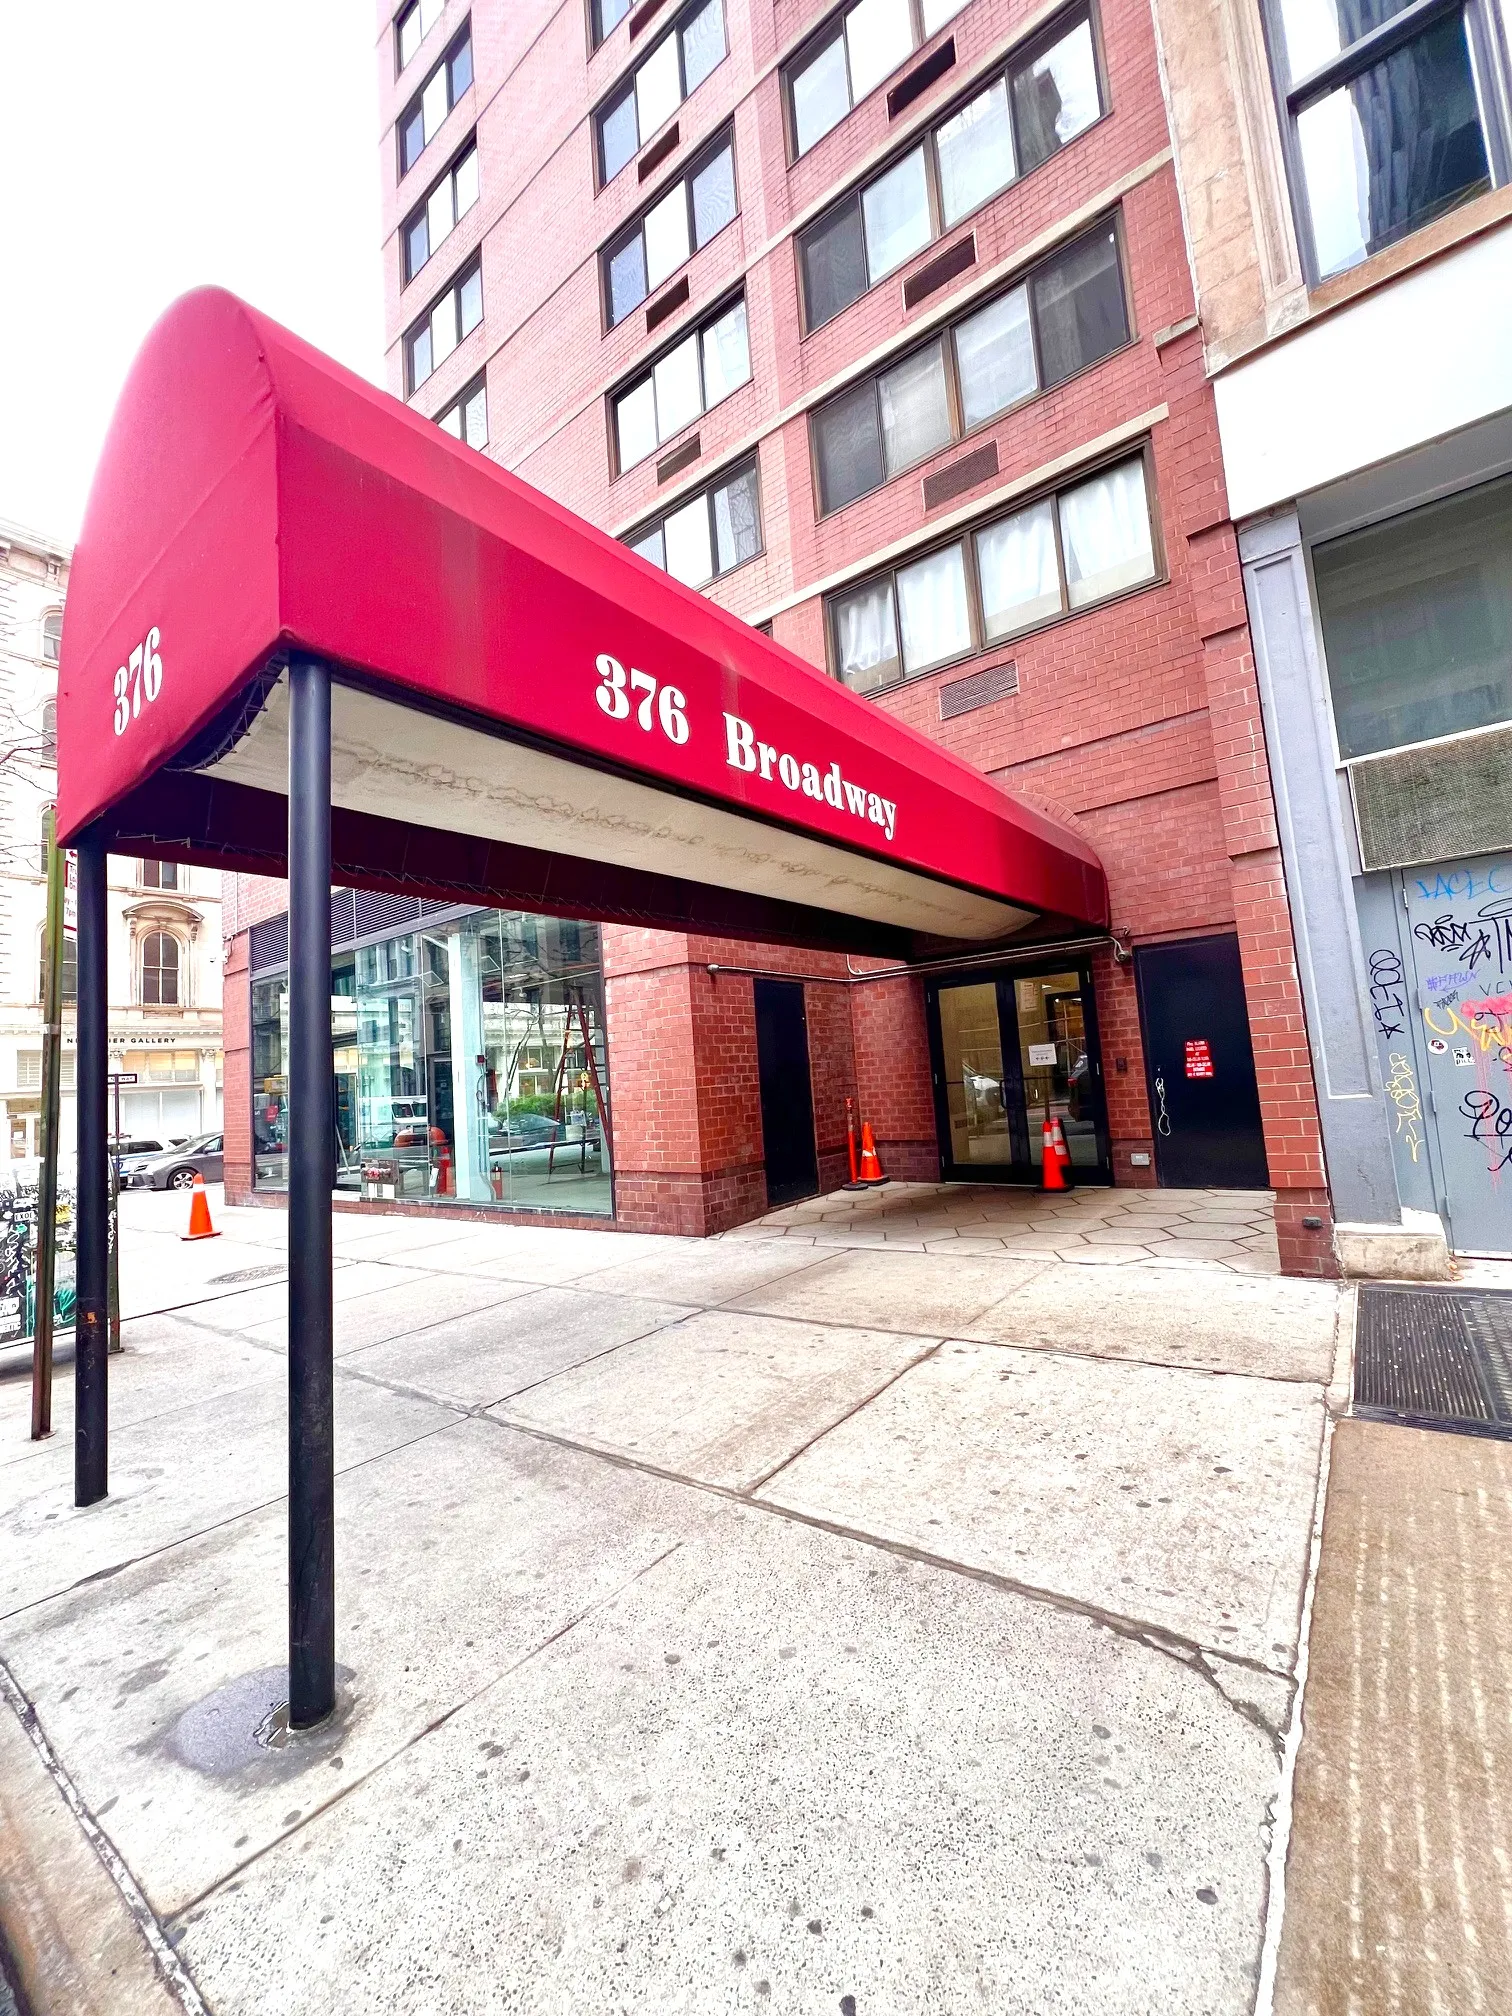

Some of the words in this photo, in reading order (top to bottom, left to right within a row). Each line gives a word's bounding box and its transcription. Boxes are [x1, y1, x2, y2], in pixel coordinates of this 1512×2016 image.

[113, 625, 163, 736] 376
[594, 653, 690, 746] 376
[722, 711, 898, 842] Broadway
